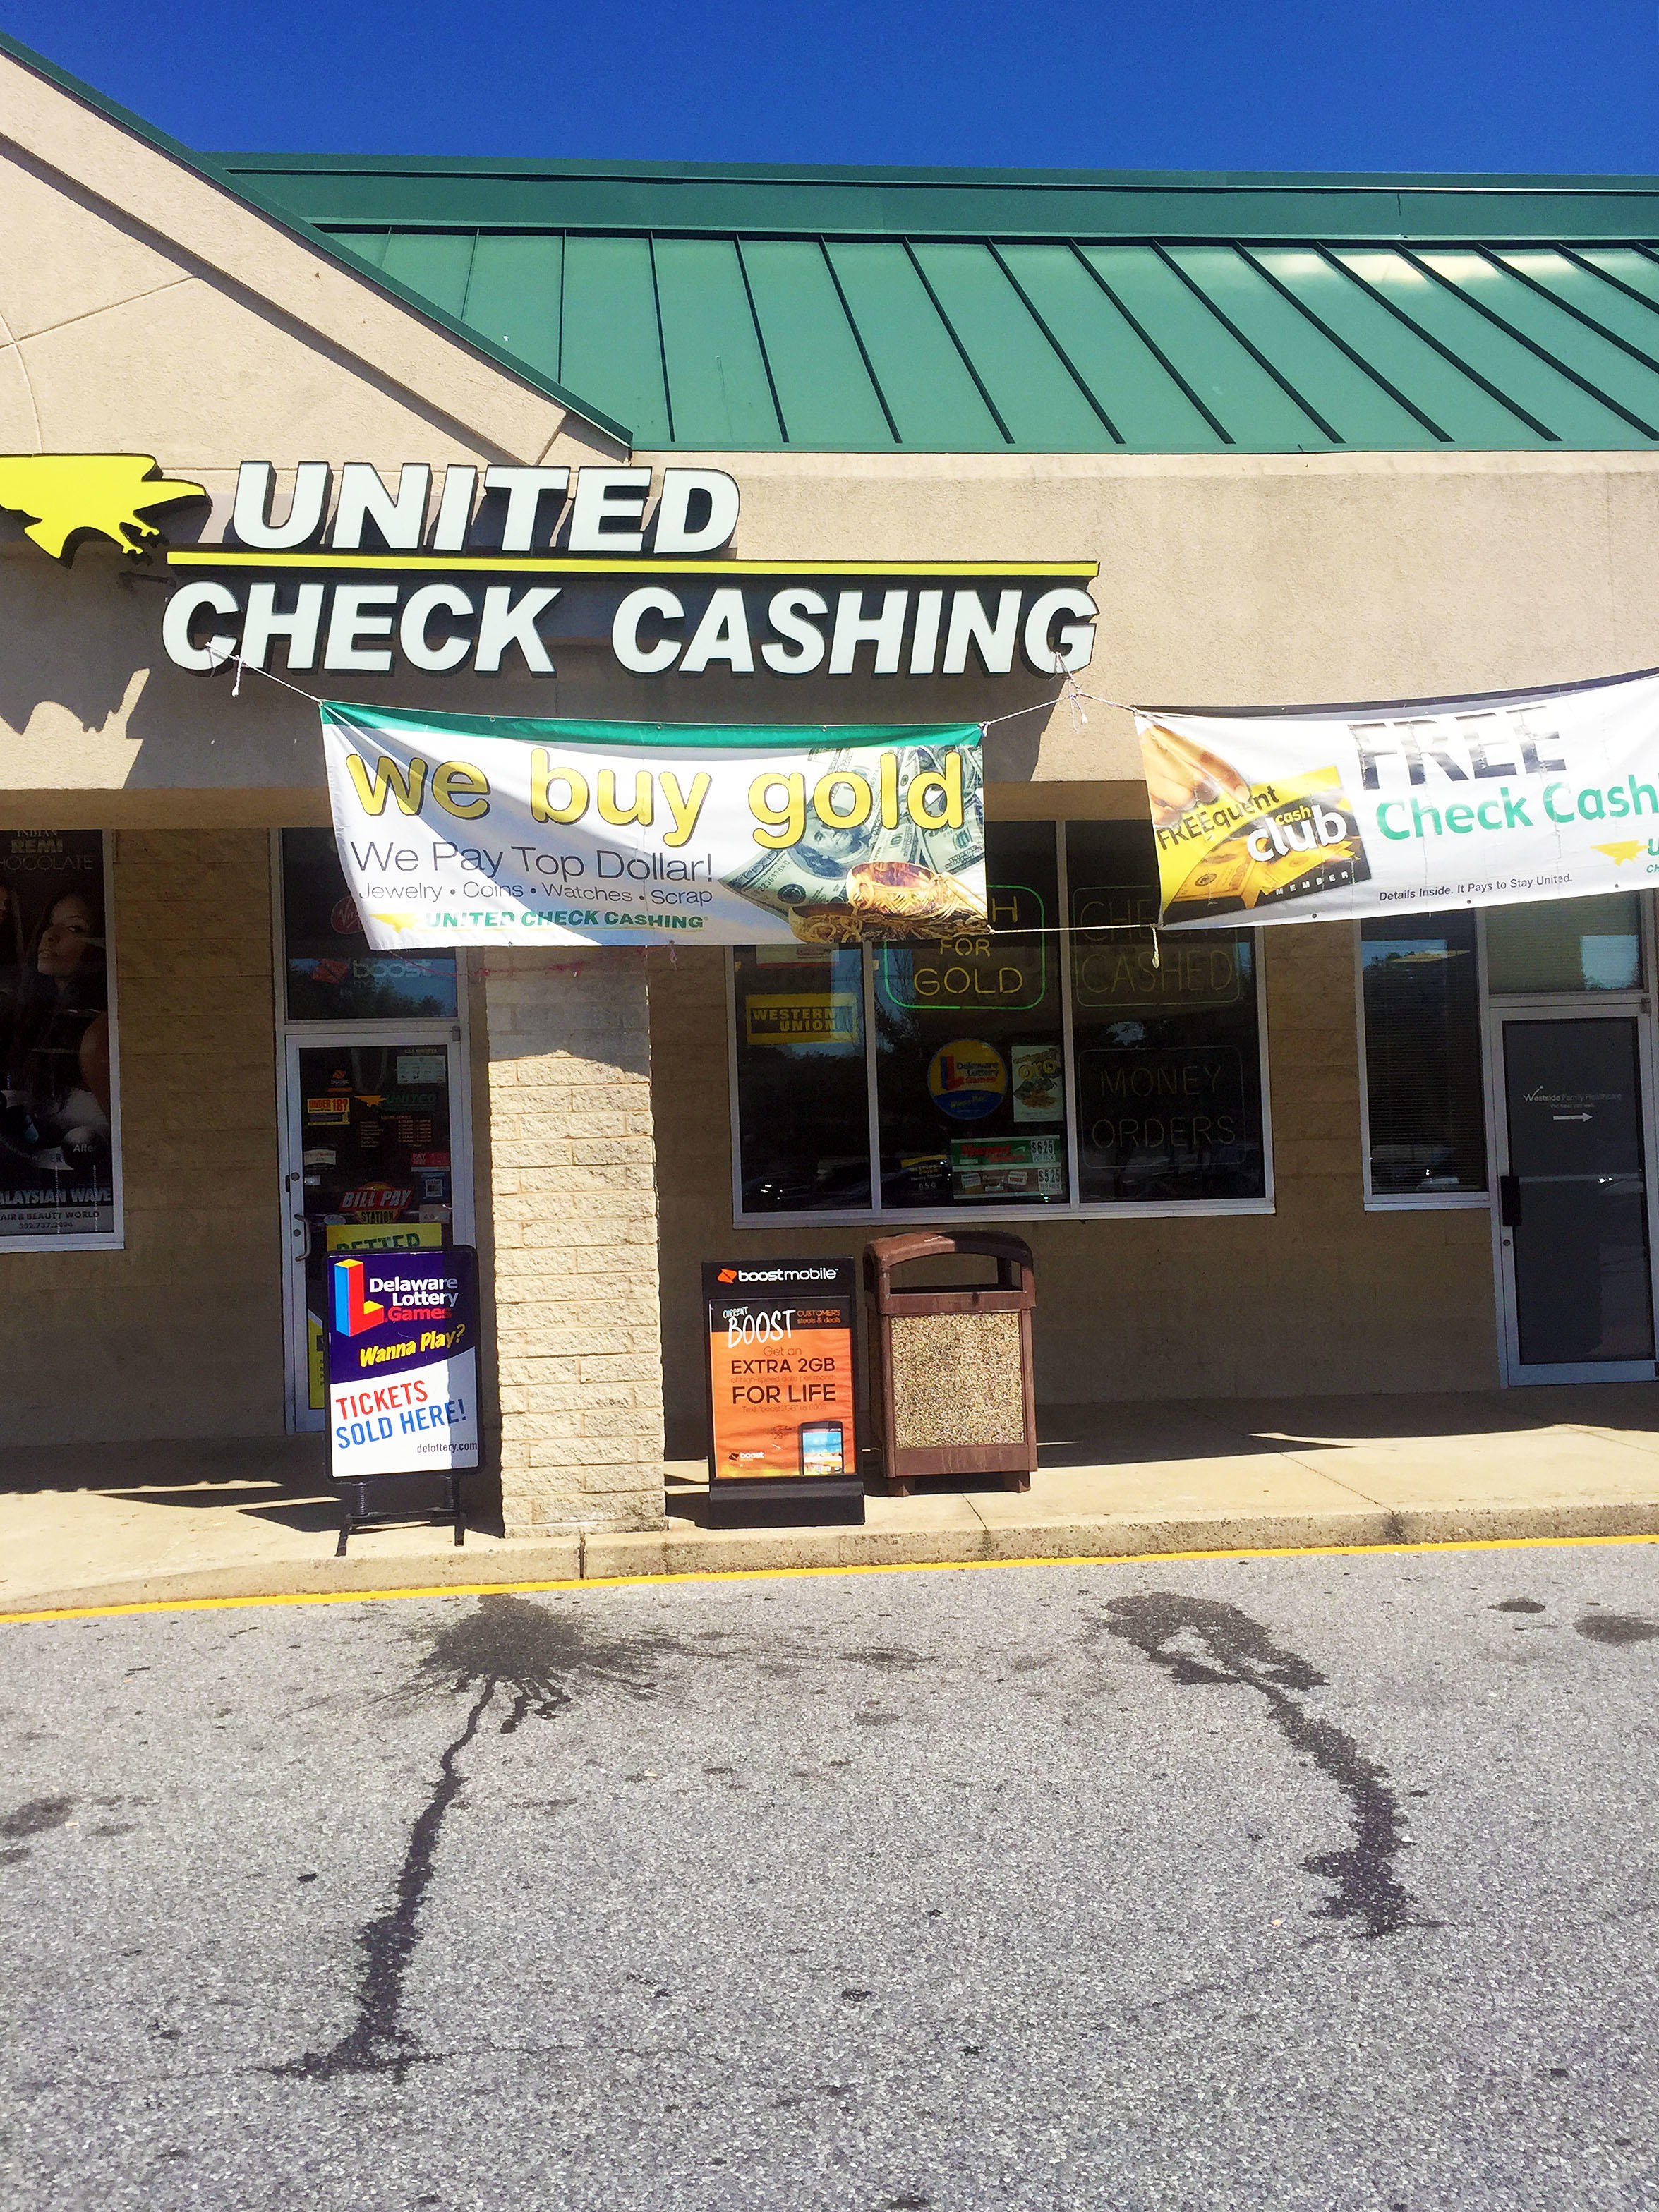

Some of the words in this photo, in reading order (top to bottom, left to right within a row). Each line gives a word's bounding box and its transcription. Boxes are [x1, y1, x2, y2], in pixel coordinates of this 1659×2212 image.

[233, 460, 741, 554] UNITED
[162, 581, 562, 674] CHECK
[611, 586, 1099, 676] CASHING
[1347, 706, 1567, 790] FREE
[346, 752, 491, 823] we
[530, 748, 713, 850] buy
[747, 749, 963, 850] gold
[1376, 787, 1534, 841] Check
[1543, 773, 1659, 823] Cash
[1274, 805, 1311, 826] cash
[1246, 804, 1348, 863] club
[350, 841, 419, 872] We
[433, 840, 504, 878] Pay
[511, 846, 585, 883] Top
[597, 850, 713, 883] Dollar!
[358, 882, 443, 902] Jewelry
[462, 881, 524, 898] Coins
[541, 882, 633, 902] Watches
[651, 889, 713, 907] Scrap
[1274, 871, 1349, 895] MEMBER
[1379, 888, 1416, 901] Details
[1418, 886, 1454, 898] Inside.
[1457, 884, 1464, 894] It
[1468, 882, 1493, 893] Pays
[1497, 881, 1507, 890] to
[1510, 878, 1533, 890] Stay
[1536, 873, 1573, 886] United.
[521, 910, 600, 926] CHECK
[604, 911, 704, 929] CASHING
[939, 937, 991, 957] FOR
[353, 960, 432, 978] boost
[1080, 949, 1233, 993] CASHED
[914, 966, 1024, 996] GOLD
[752, 1008, 835, 1020] WESTERN
[779, 1020, 835, 1032] UNION
[1101, 1065, 1223, 1099] MONEY
[309, 1099, 331, 1108] UNDER
[332, 1099, 348, 1111] 18?
[1091, 1114, 1236, 1149] ORDERS
[71, 1187, 111, 1202] WAVE
[342, 1191, 377, 1209] BILL
[379, 1190, 412, 1207] PAY
[361, 1210, 394, 1223] STATION
[369, 1276, 458, 1293] Delaware
[392, 1292, 459, 1307] Lottery
[387, 1306, 452, 1322] Games
[796, 1309, 841, 1317] CUSTOMERS
[728, 1310, 797, 1348] BOOST
[359, 1340, 416, 1367] Wanna
[420, 1323, 466, 1352] Play?
[763, 1346, 784, 1356] Get
[787, 1347, 802, 1356] an
[731, 1358, 792, 1374] EXTRA
[797, 1357, 835, 1372] 2GB
[335, 1379, 428, 1420] TICKETS
[732, 1384, 781, 1404] FOR
[788, 1383, 836, 1403] LIFE
[335, 1416, 394, 1449] SOLD
[399, 1398, 466, 1434] HERE!
[416, 1442, 478, 1453] delottery.com
